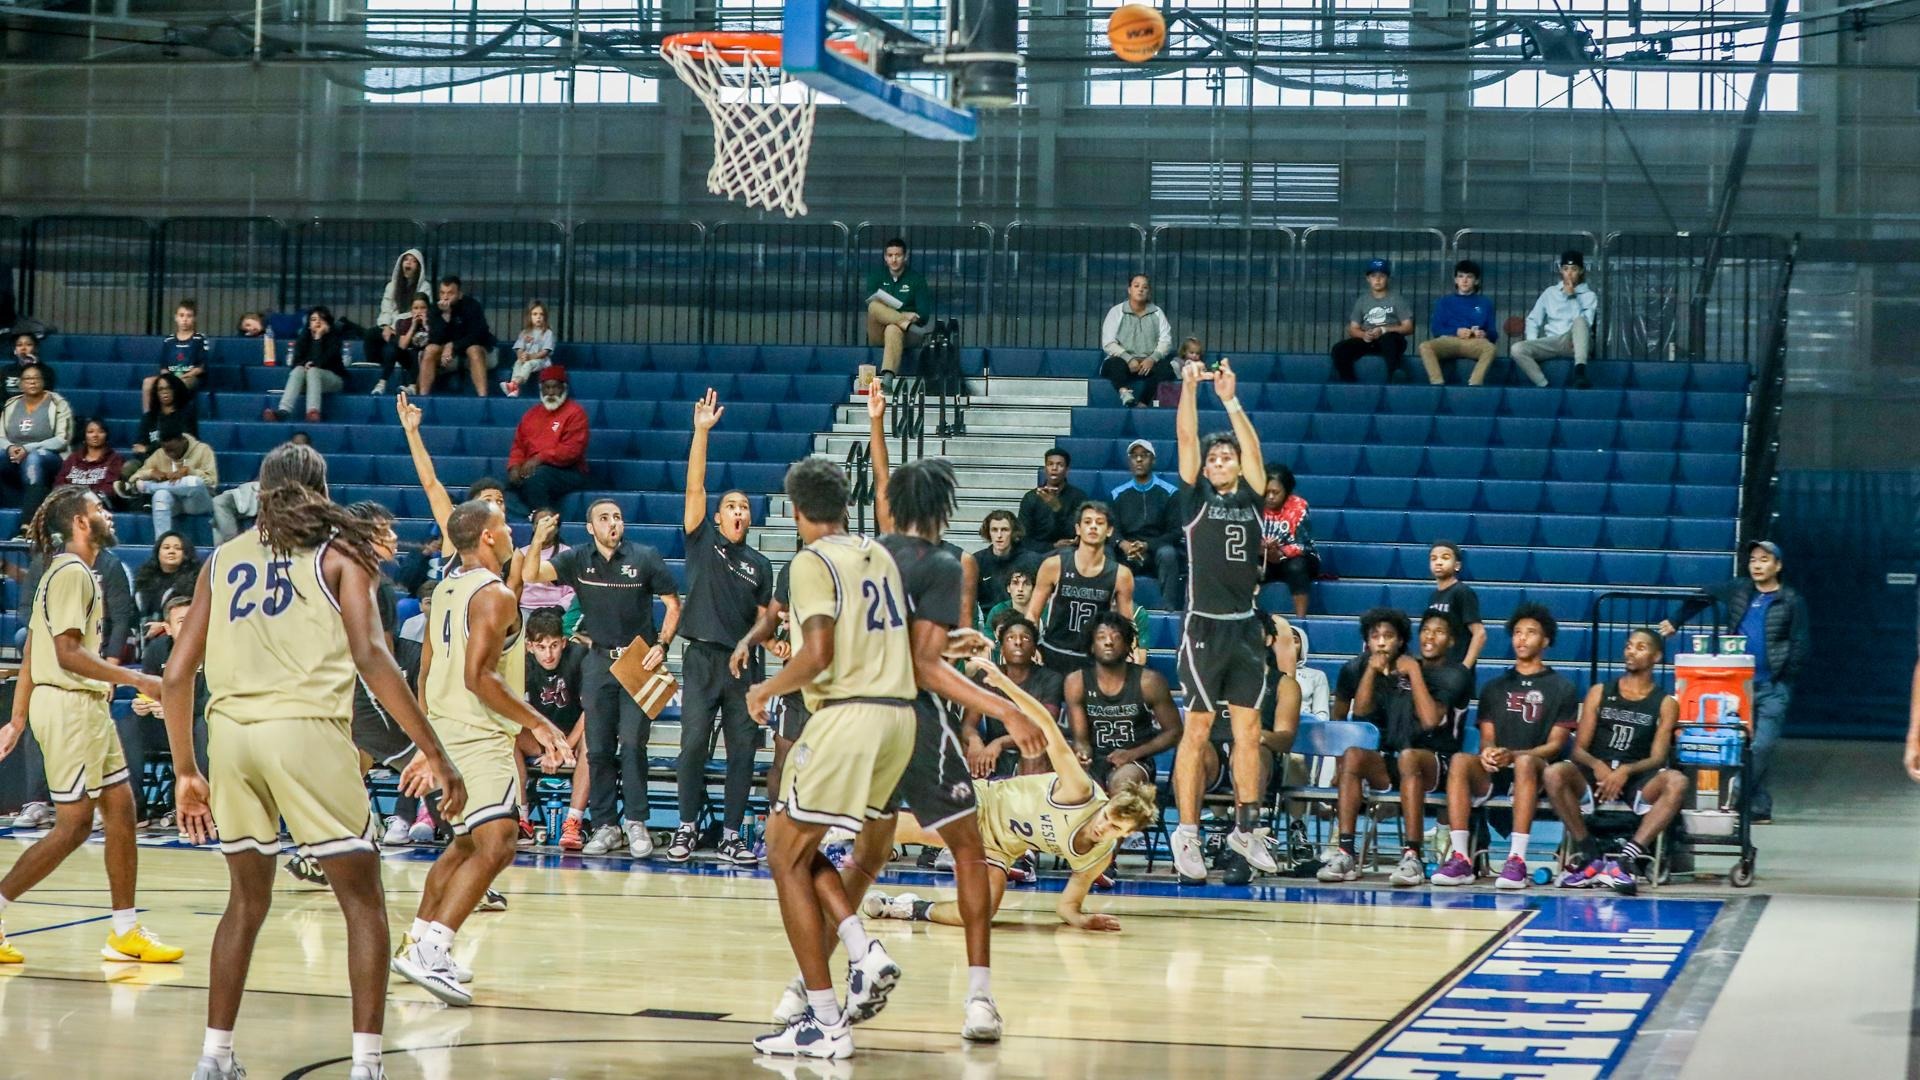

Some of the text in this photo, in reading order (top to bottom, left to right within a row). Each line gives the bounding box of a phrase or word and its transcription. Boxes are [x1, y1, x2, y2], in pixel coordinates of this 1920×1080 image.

[1225, 524, 1247, 562] 2
[227, 561, 294, 624] 25
[862, 576, 904, 632] 21
[1061, 584, 1110, 601] EAGLE
[442, 609, 452, 659] 4
[1069, 601, 1098, 633] 12
[1087, 704, 1138, 717] EAGLES
[1093, 720, 1135, 749] 23
[1009, 817, 1034, 838] 2
[1473, 928, 1695, 980] THE
